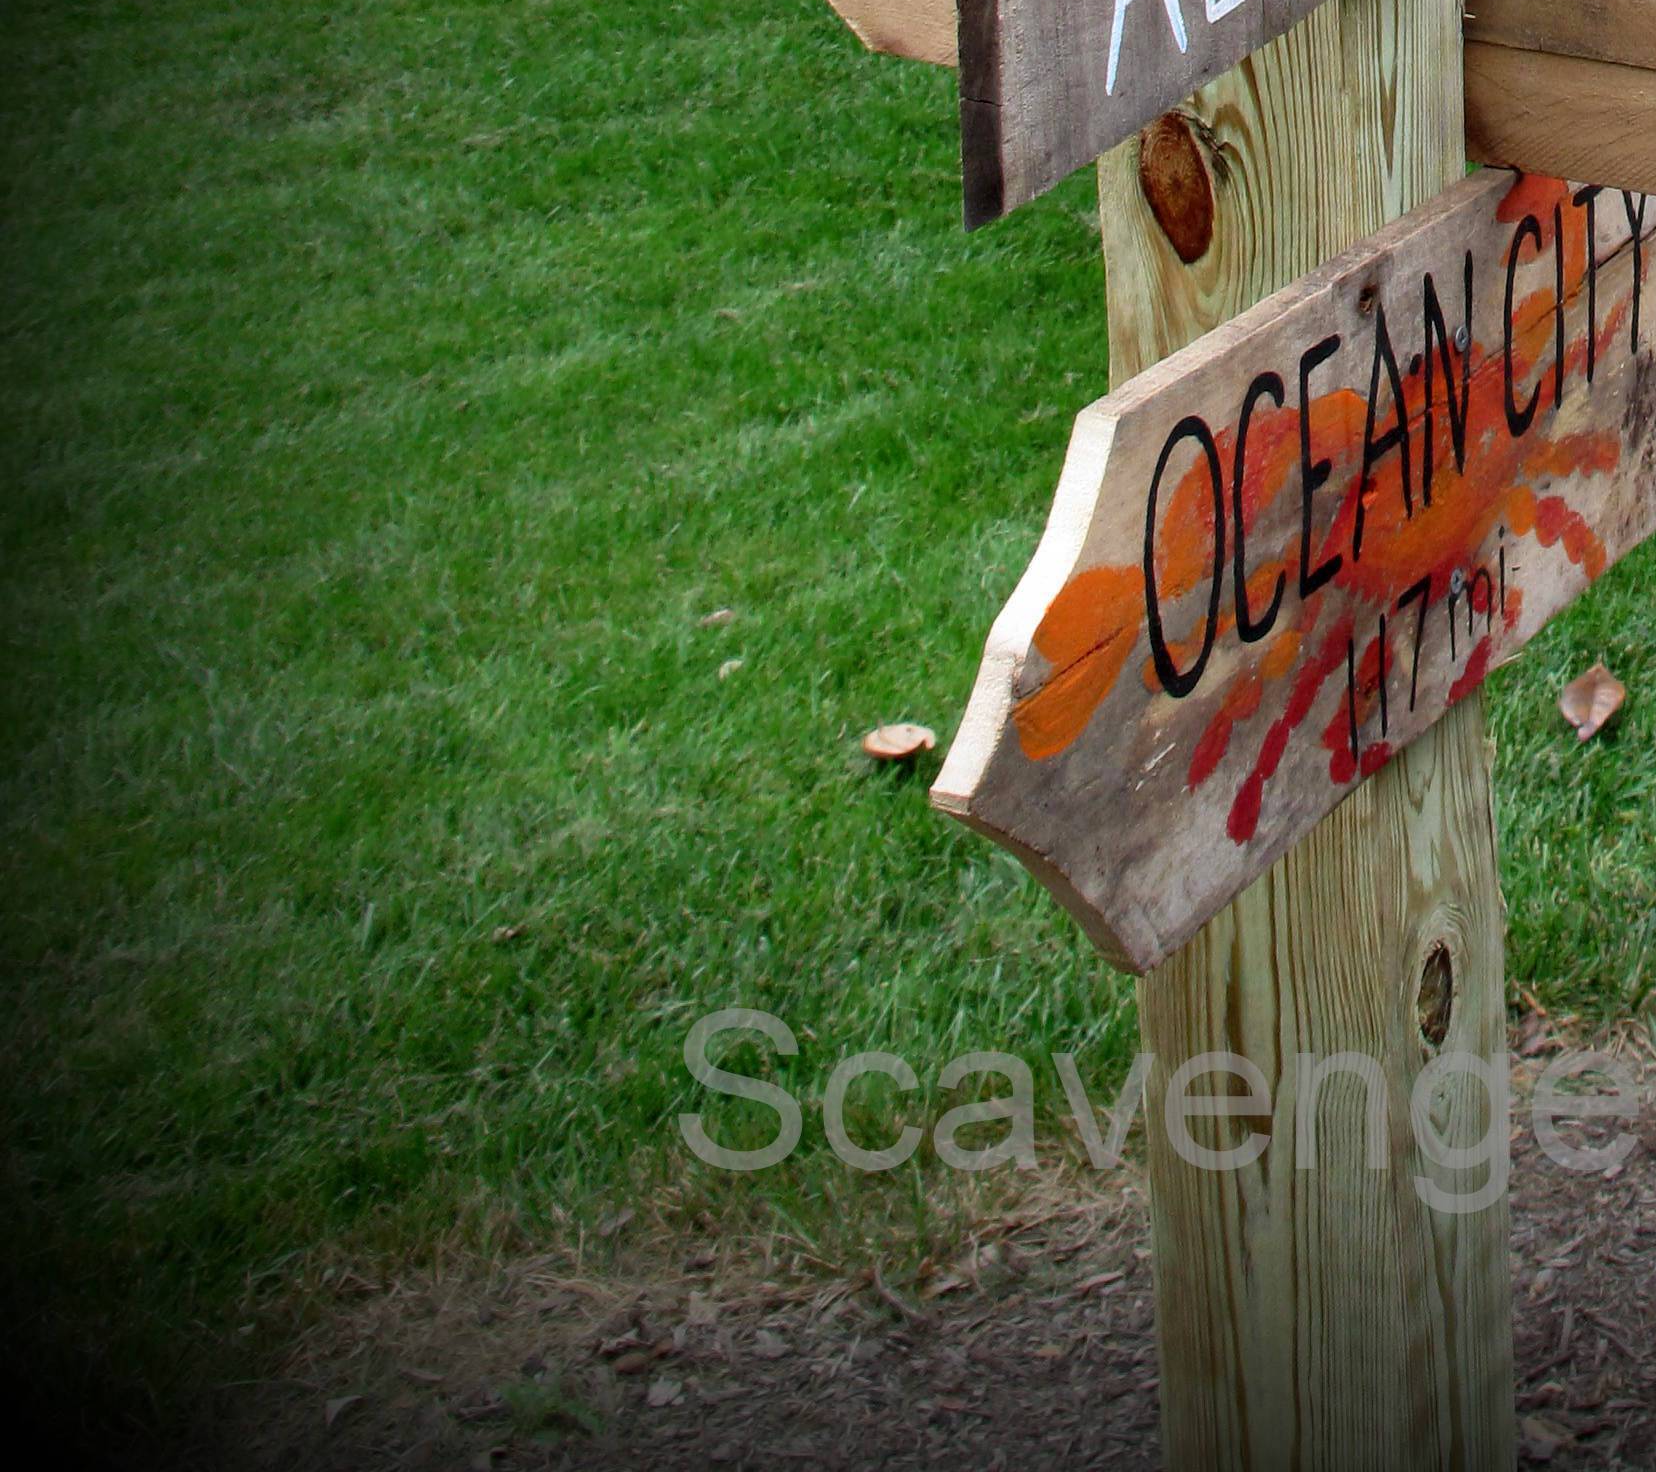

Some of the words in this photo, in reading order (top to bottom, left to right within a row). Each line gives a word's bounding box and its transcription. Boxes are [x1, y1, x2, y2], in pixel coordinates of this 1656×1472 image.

[1142, 249, 1475, 699] OCEAN
[1502, 184, 1648, 438] CITY
[1347, 573, 1432, 764] 117
